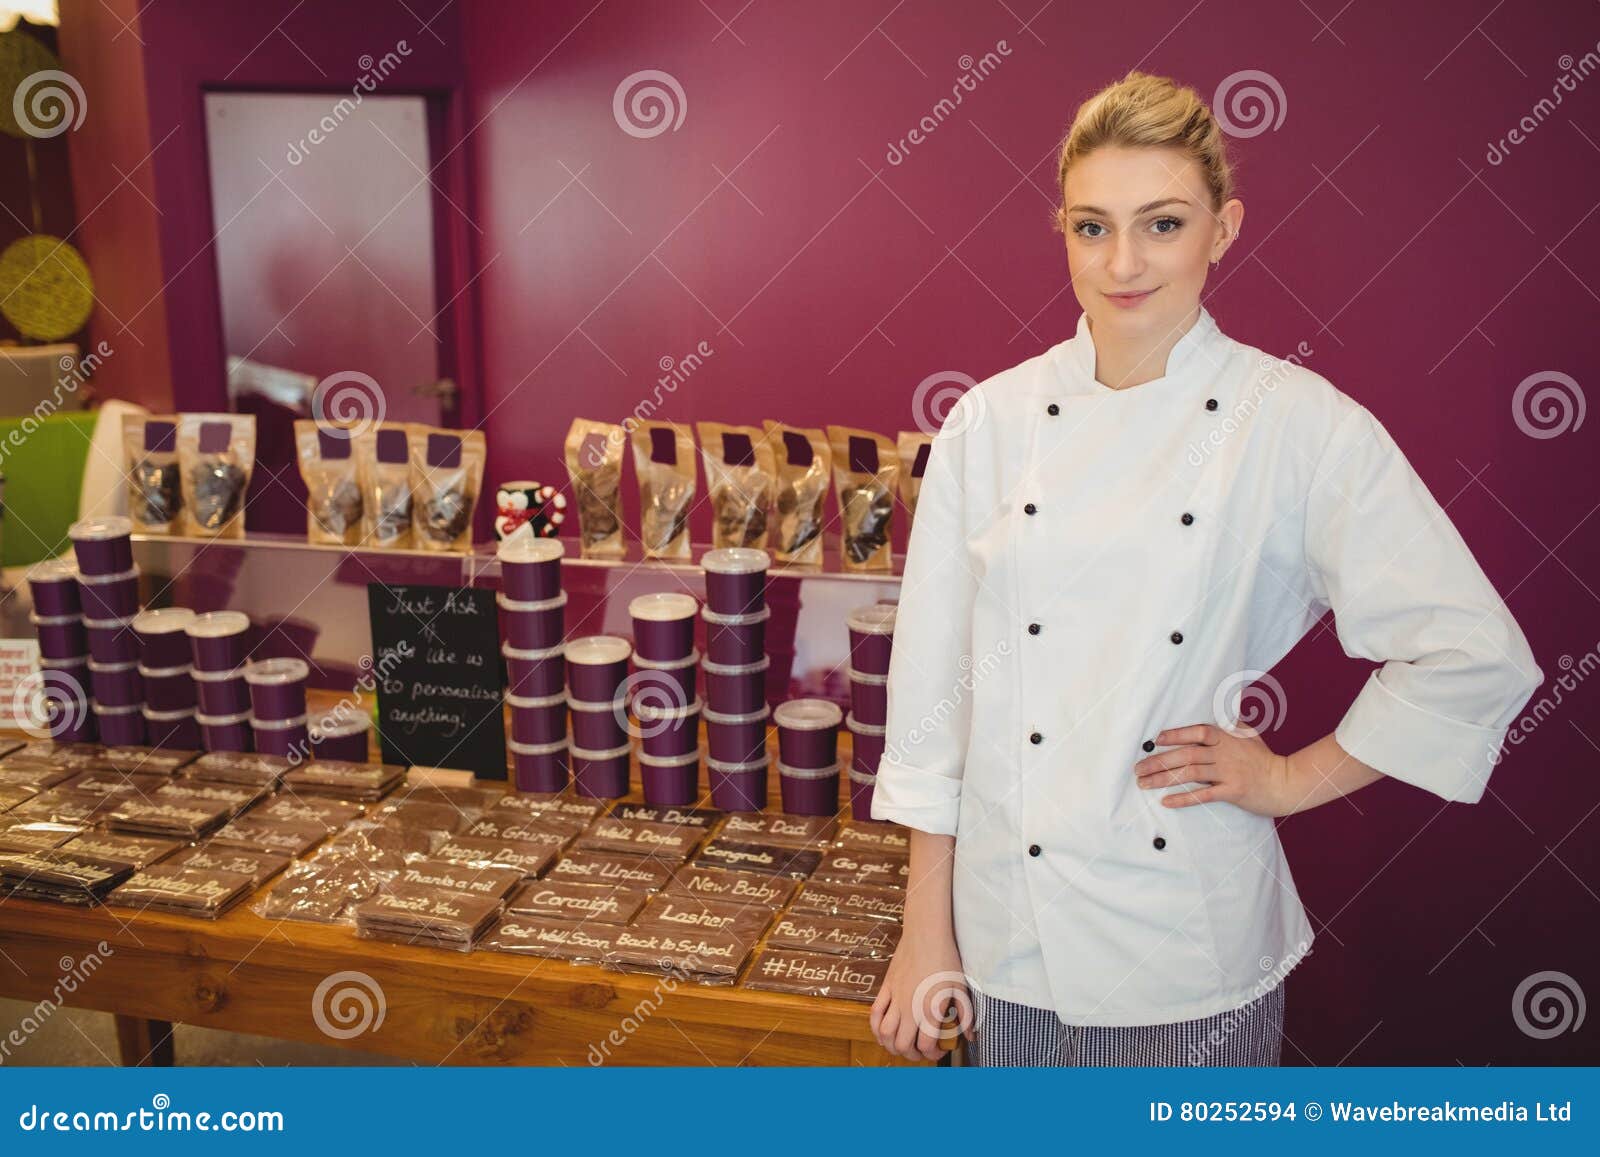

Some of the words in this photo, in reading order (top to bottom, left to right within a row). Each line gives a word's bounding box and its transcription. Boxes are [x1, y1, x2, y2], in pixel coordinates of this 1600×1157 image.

[387, 588, 434, 615] Just
[443, 592, 479, 615] Ask
[426, 648, 457, 665] like
[383, 679, 403, 694] to
[412, 682, 499, 700] personalise
[662, 809, 704, 825] Done
[725, 816, 767, 832] Best
[769, 820, 808, 836] Dad
[502, 826, 571, 847] Grumpy
[596, 826, 632, 842] Well
[635, 828, 683, 847] Done
[840, 827, 881, 843] From
[492, 849, 539, 866] Days
[703, 845, 773, 864] Congrats
[555, 858, 600, 875] Best
[832, 857, 858, 870] Go
[856, 863, 894, 882] get
[687, 875, 730, 893] New
[732, 880, 781, 904] Baby
[799, 889, 844, 908] Happy
[376, 894, 429, 914] Thank
[428, 902, 460, 918] You
[500, 924, 538, 939] Get
[566, 932, 611, 949] Soon
[615, 933, 660, 950] Back
[659, 936, 677, 950] to
[675, 939, 735, 957] School
[774, 921, 823, 945] Party
[826, 930, 888, 949] Animal
[762, 957, 876, 994] #Hashtag
